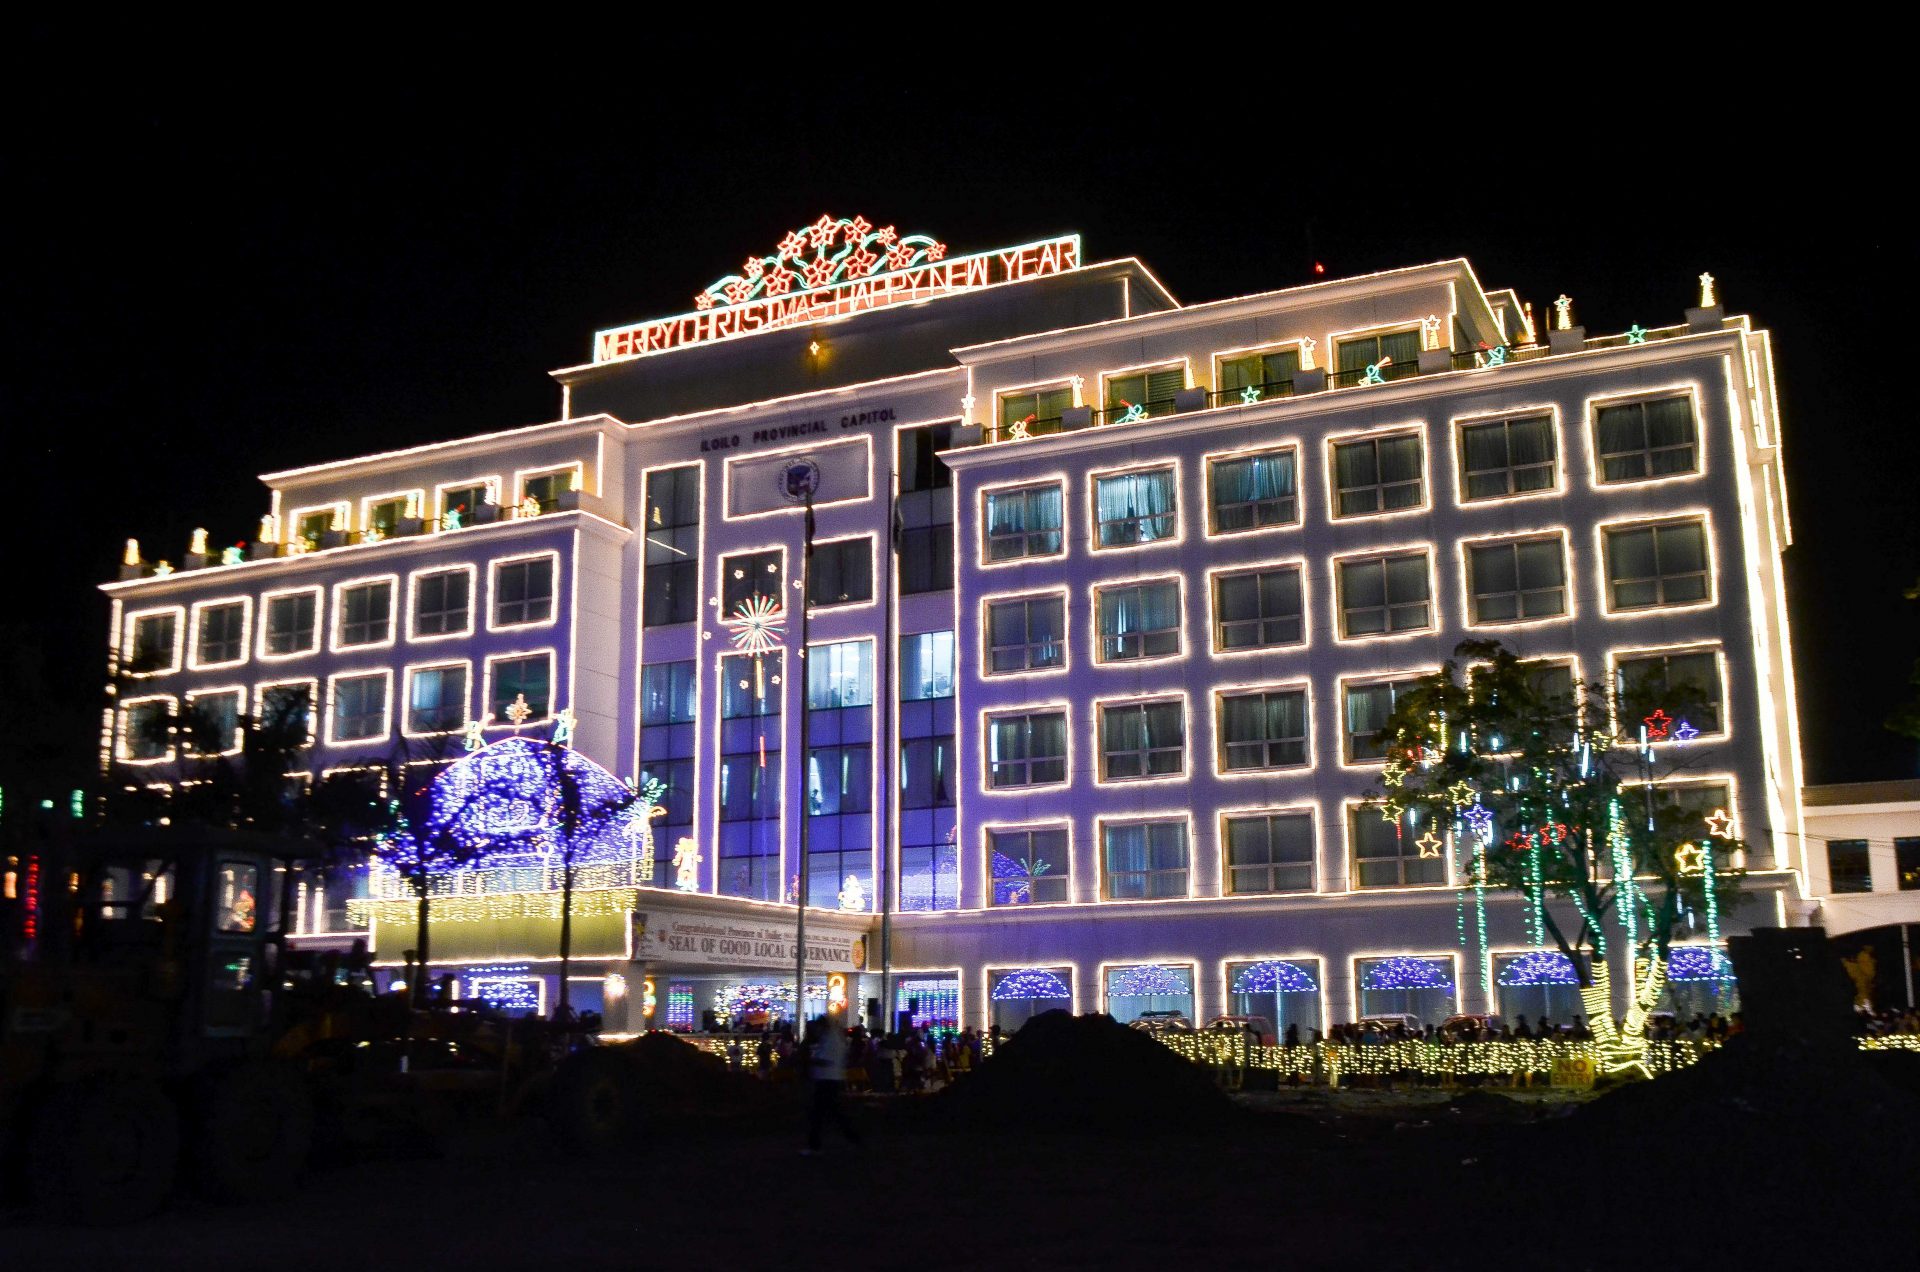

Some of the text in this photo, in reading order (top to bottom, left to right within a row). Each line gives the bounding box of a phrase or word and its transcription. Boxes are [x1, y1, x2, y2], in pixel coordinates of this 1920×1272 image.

[600, 239, 1079, 363] MERRY CHRISTMAS HAPPY NEW YEAR
[701, 407, 896, 453] ILOILO PROVINCIAL CAPITOL
[669, 935, 697, 953] SEAL
[701, 937, 715, 954] OF
[720, 939, 751, 956] GOOD
[754, 941, 786, 959] LOCAL
[1558, 1059, 1588, 1072] NO
